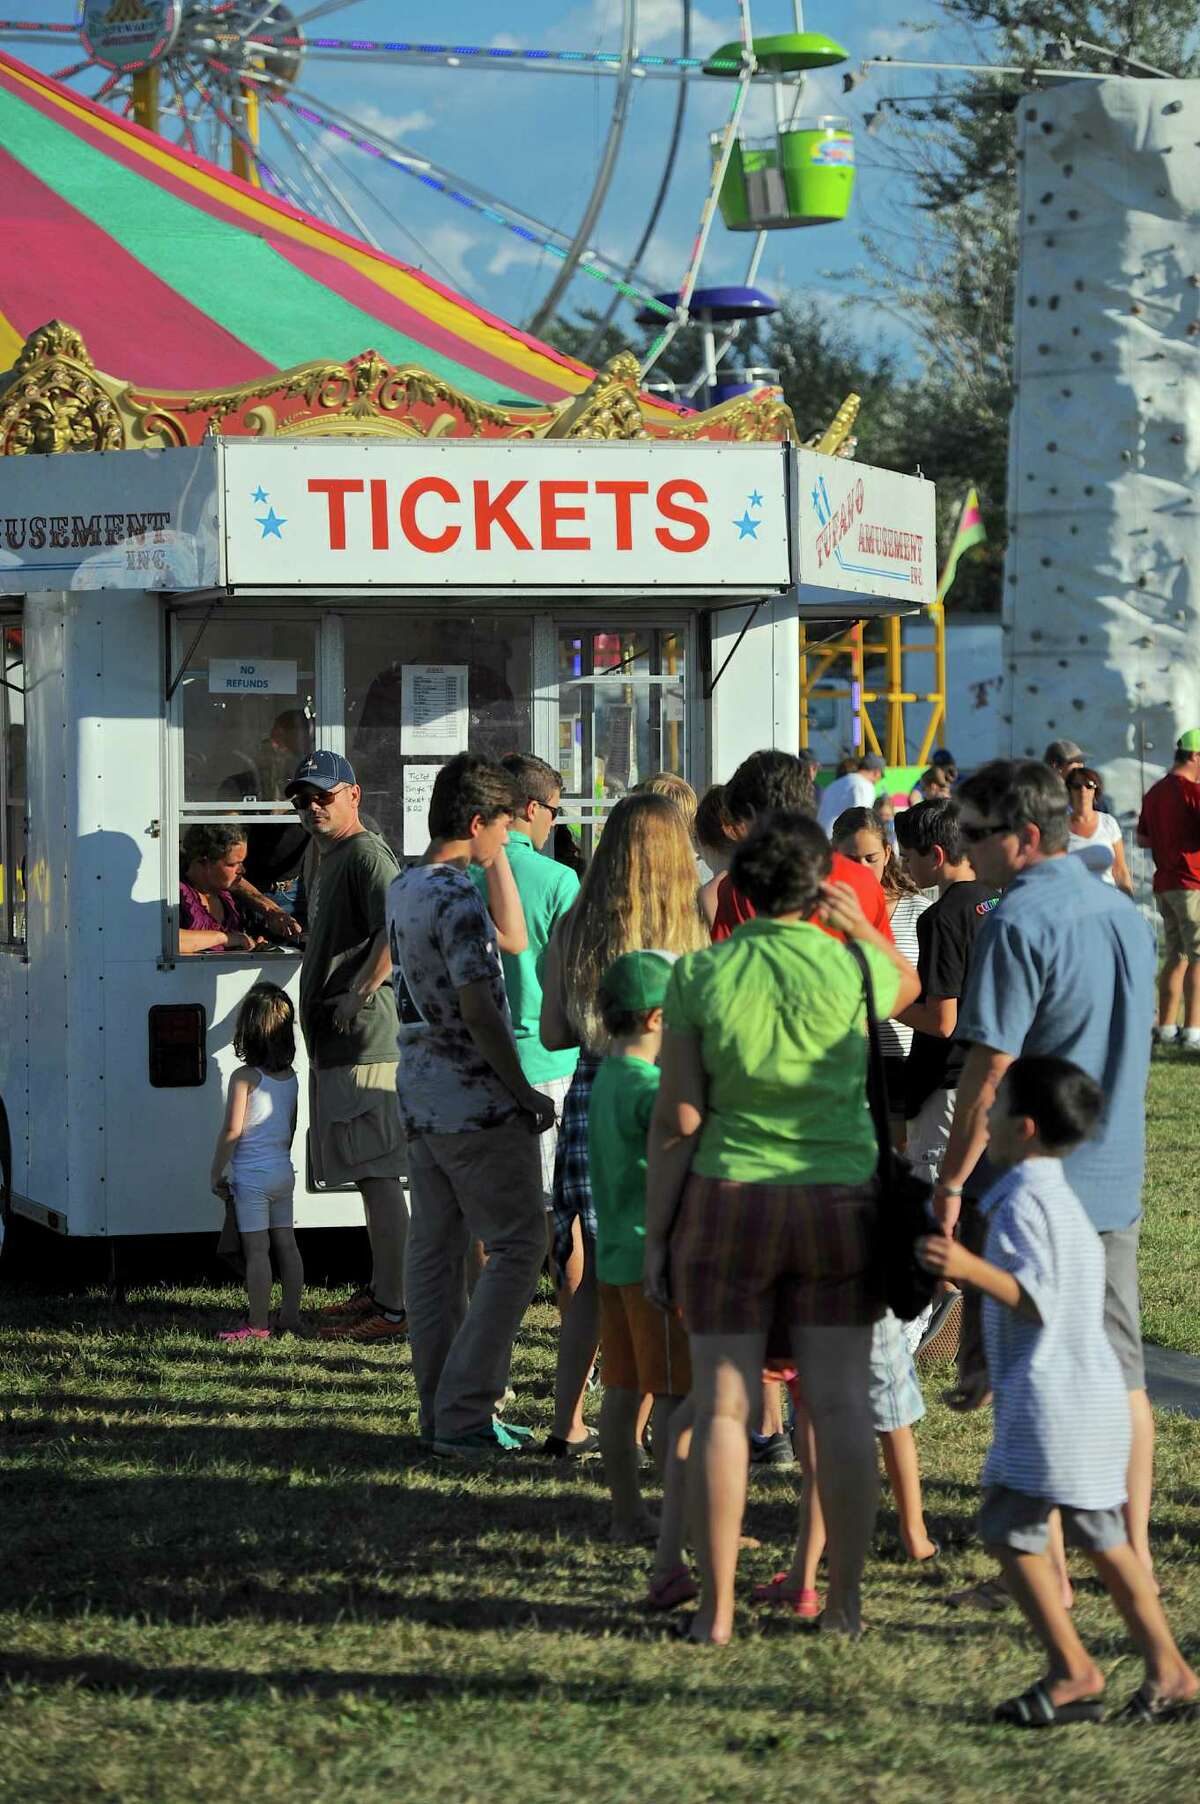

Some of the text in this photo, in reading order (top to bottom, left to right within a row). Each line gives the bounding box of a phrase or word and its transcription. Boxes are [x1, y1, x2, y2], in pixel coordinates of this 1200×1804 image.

[307, 476, 711, 553] TICKETS
[0, 512, 171, 550] USEMENT
[858, 523, 924, 563] AMUSEMENT
[126, 549, 171, 571] INC.
[226, 679, 269, 689] REFUNDS
[240, 666, 256, 675] NO
